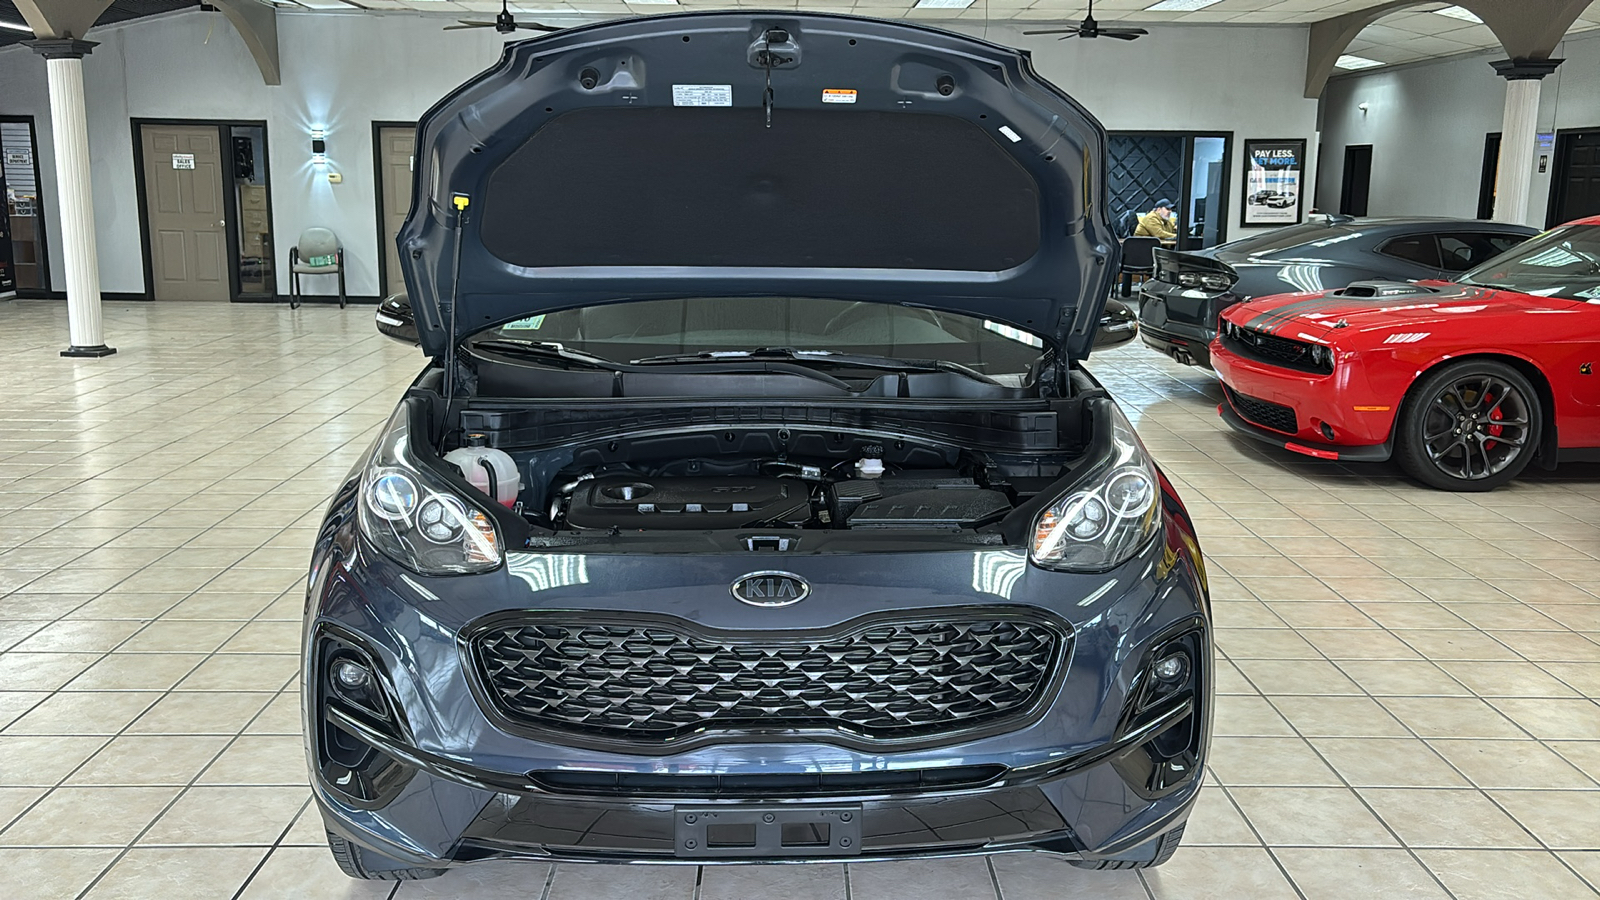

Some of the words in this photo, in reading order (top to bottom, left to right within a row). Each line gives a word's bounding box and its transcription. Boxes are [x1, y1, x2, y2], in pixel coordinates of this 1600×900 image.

[1254, 149, 1271, 158] PAY
[1272, 149, 1295, 158] LESS.
[1270, 157, 1298, 165] MORE.
[745, 578, 798, 598] KIA
